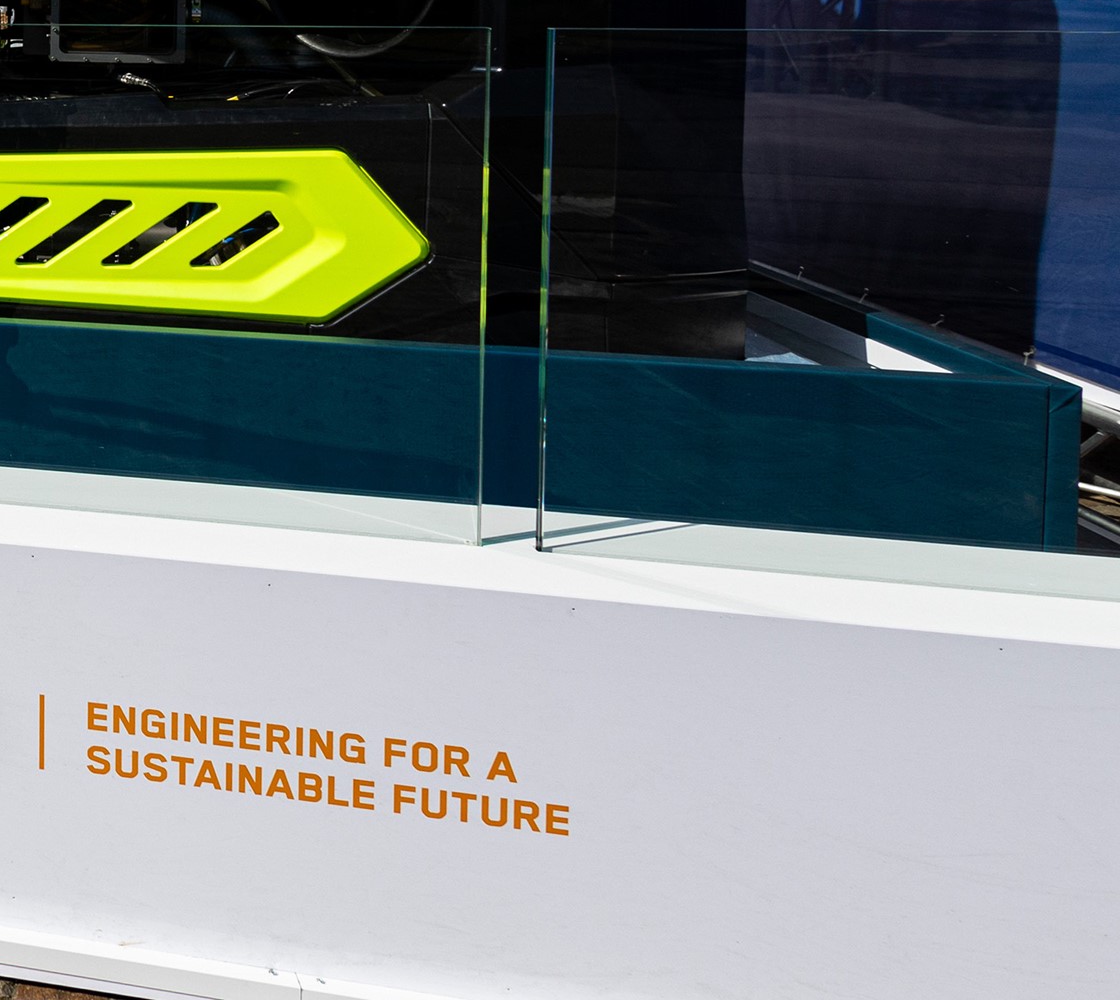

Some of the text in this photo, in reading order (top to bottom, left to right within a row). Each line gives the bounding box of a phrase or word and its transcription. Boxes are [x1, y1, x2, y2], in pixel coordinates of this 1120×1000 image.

[87, 701, 518, 784] ENGINEERING FOR A
[86, 745, 570, 837] SUSTAINABLE FUTURE
